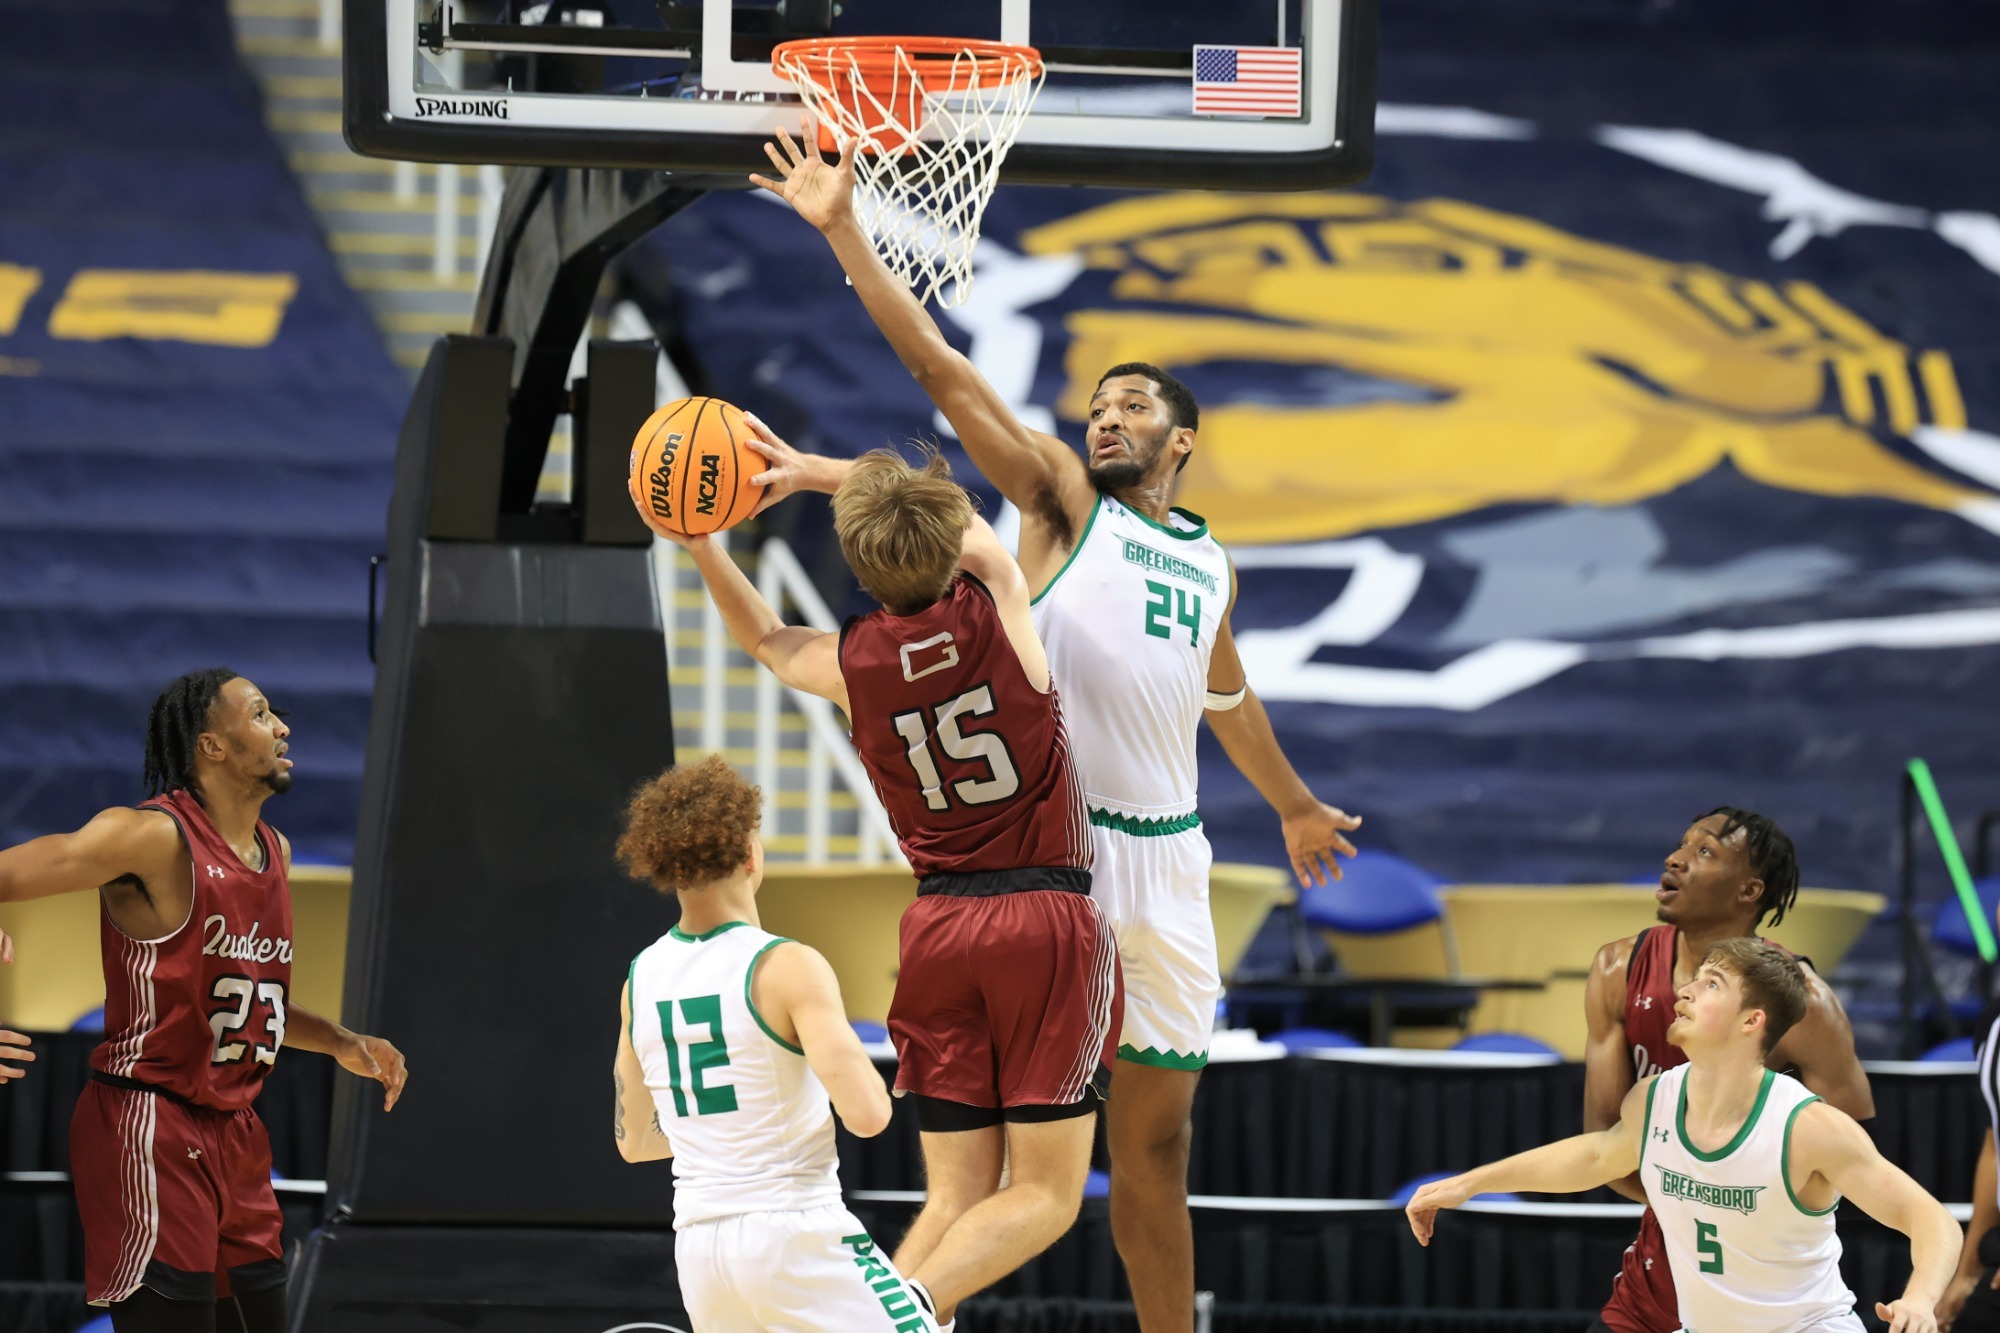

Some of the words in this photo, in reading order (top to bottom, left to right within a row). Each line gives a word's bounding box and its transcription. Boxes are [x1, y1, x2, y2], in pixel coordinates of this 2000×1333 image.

[415, 97, 508, 120] SPALDING
[650, 433, 683, 518] Wilson
[696, 455, 720, 515] NCAA
[1123, 540, 1218, 595] GREENSBORO
[1145, 579, 1201, 648] 24
[900, 631, 960, 682] G
[892, 683, 1021, 812] 15
[203, 914, 293, 964] Quaker
[207, 975, 287, 1067] 23
[656, 994, 738, 1117] 12
[1662, 1170, 1755, 1212] GREENSBORO
[1694, 1218, 1724, 1275] 5
